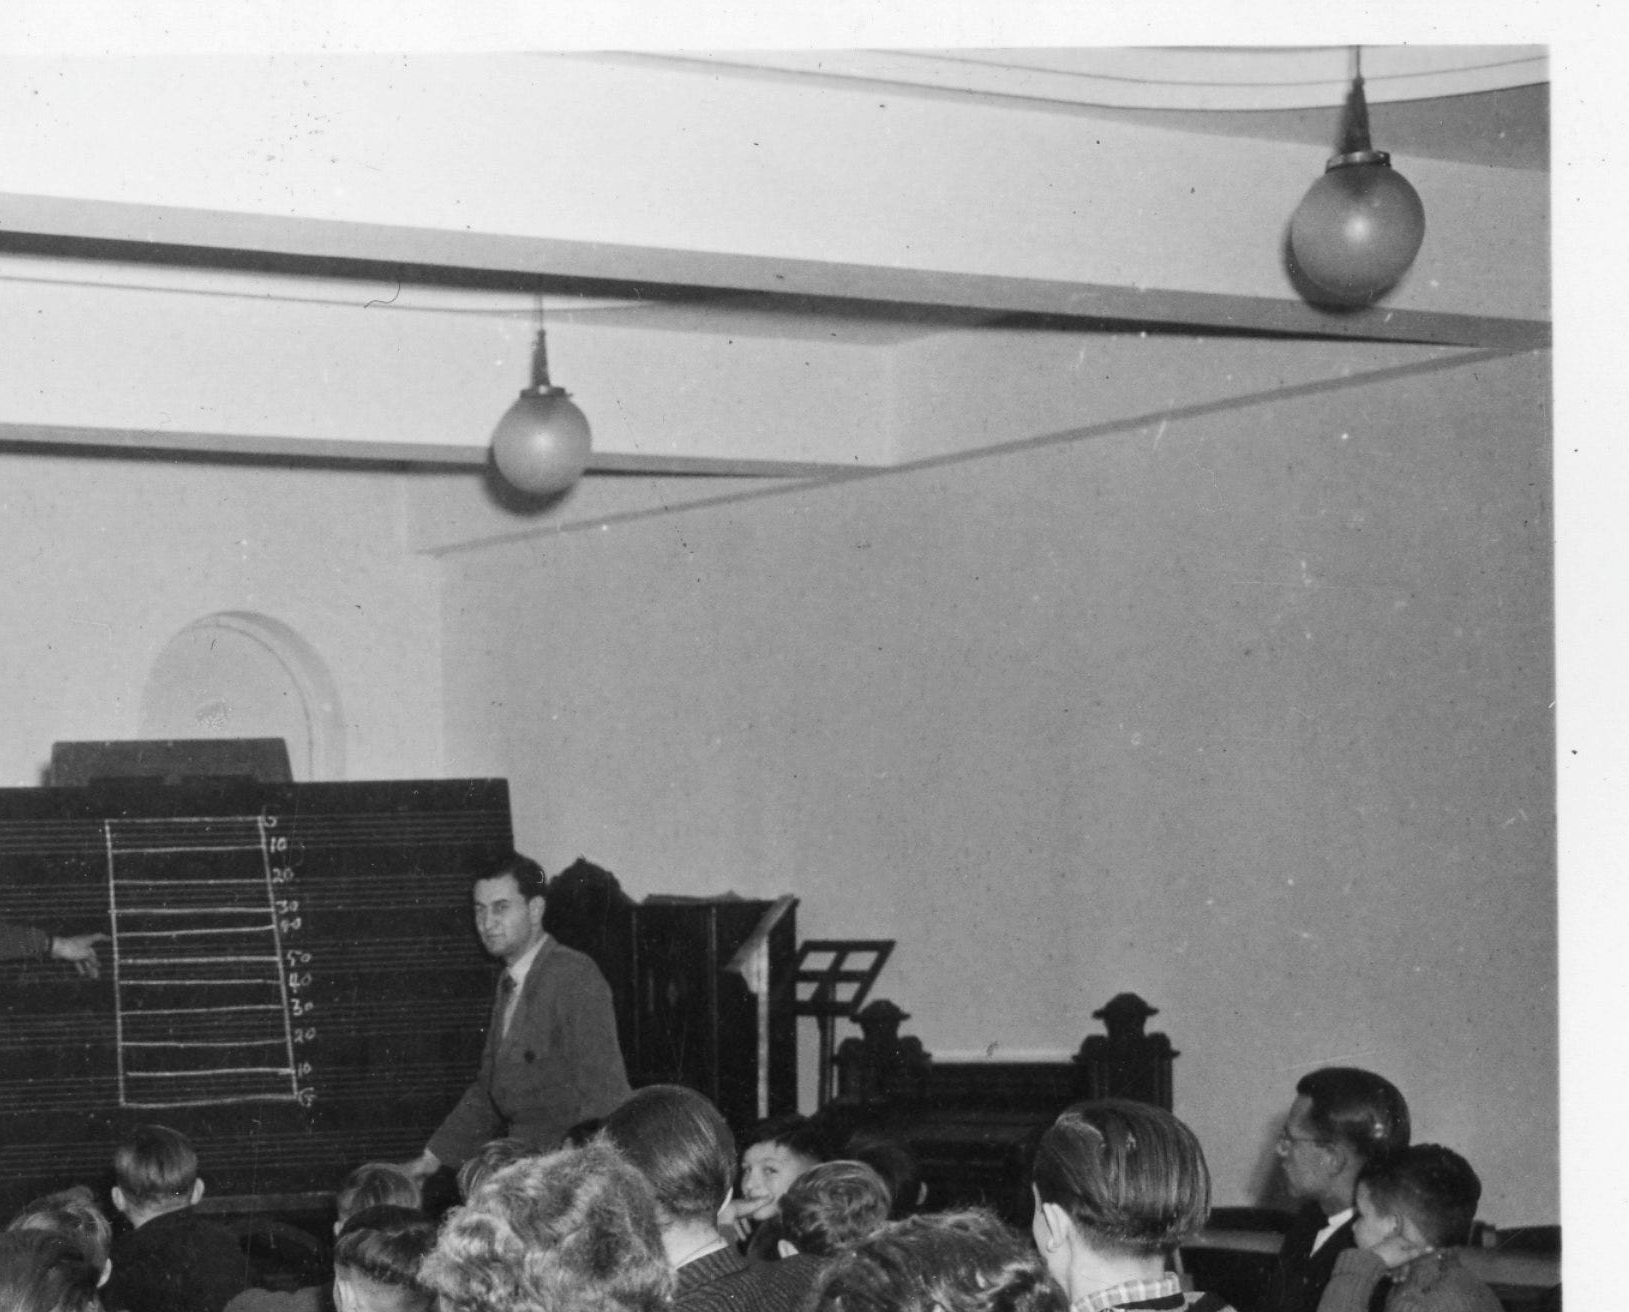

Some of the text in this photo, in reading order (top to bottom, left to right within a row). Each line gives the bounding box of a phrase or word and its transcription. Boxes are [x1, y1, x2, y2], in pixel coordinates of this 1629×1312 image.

[270, 836, 287, 853] 10
[272, 867, 294, 884] 20
[275, 900, 299, 914] 30
[280, 917, 302, 933] 40
[287, 949, 312, 967] 50
[289, 972, 312, 994] 40
[290, 998, 314, 1016] 30
[294, 1027, 316, 1043] 20
[297, 1062, 313, 1078] 10
